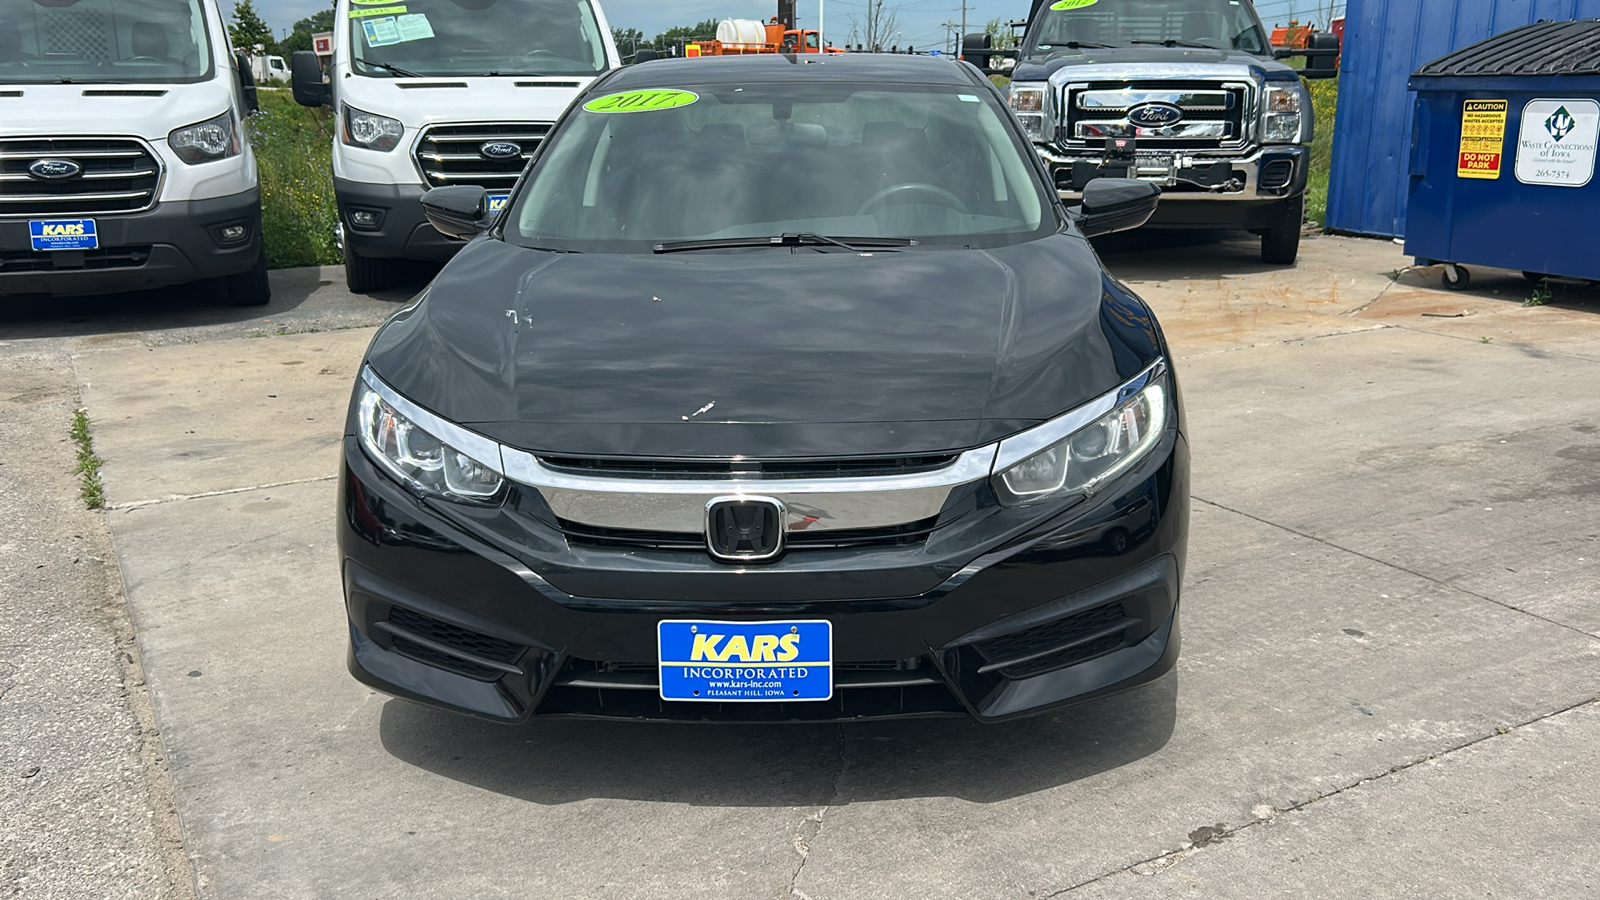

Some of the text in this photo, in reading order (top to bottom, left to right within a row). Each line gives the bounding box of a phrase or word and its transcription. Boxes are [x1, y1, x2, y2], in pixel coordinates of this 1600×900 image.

[597, 92, 682, 110] 2017
[1141, 108, 1170, 120] Ford
[1464, 153, 1496, 162] DO NOT
[1467, 161, 1490, 169] PARK
[1535, 170, 1570, 179] 265-7374
[489, 199, 508, 210] KA
[42, 223, 85, 236] KARS
[690, 633, 800, 662] KARS
[683, 667, 808, 679] INCORPORATED
